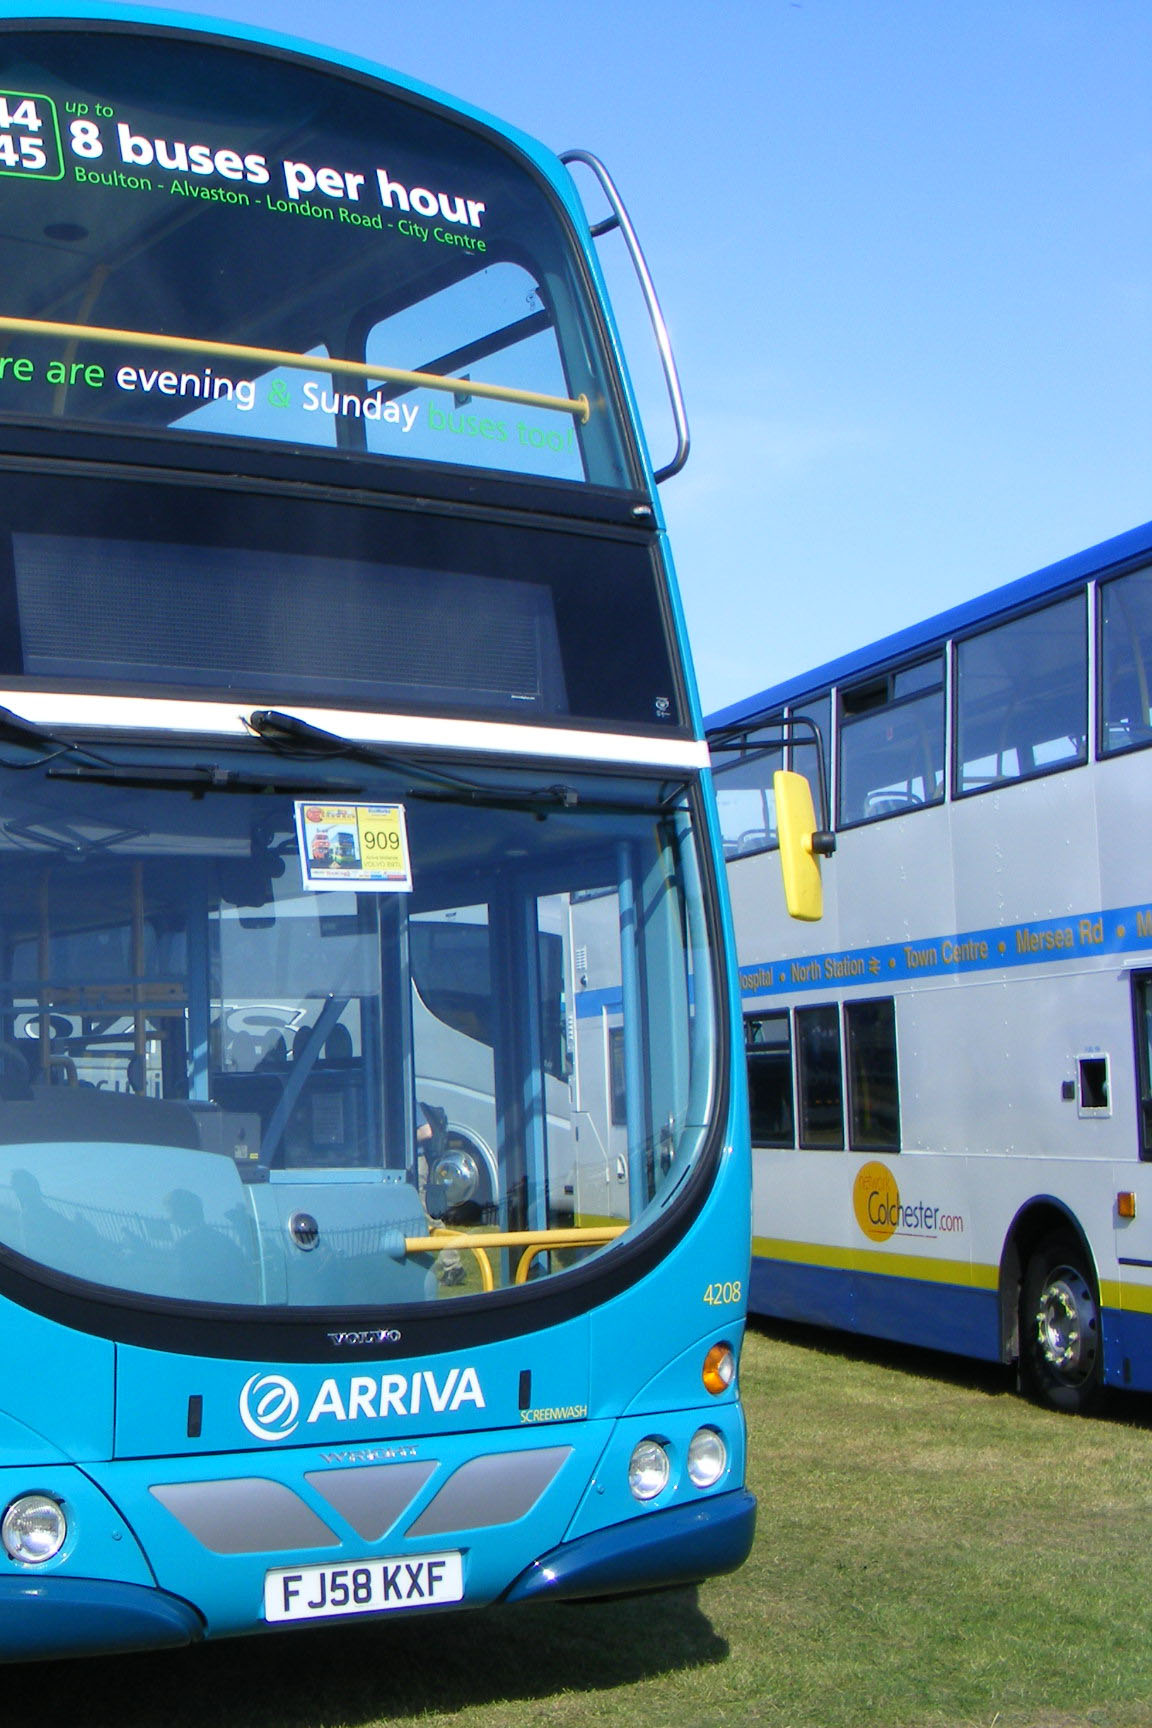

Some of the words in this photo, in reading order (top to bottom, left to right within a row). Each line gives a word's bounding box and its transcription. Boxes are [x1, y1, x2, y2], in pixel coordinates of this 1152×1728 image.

[65, 100, 88, 118] up
[95, 103, 114, 118] to
[69, 119, 103, 159] 8
[117, 122, 270, 184] buses
[283, 160, 365, 200] per
[376, 168, 486, 228] hour
[74, 166, 152, 191] Boulton
[170, 179, 250, 206] Alvaston
[266, 195, 334, 220] London
[339, 207, 383, 229] Road
[398, 220, 429, 242] City
[434, 227, 486, 252] Centre
[46, 360, 105, 388] are
[116, 365, 256, 411] evening
[267, 378, 291, 409] &
[302, 381, 419, 433] Sunday
[428, 401, 508, 442] buses
[364, 831, 400, 850] 909
[791, 960, 822, 983] North
[824, 956, 865, 979] Station
[904, 946, 938, 969] Town
[941, 940, 989, 964] Centre
[1015, 926, 1074, 953] Mersea
[1079, 917, 1104, 945] Rd
[703, 1281, 741, 1305] 4208
[328, 1329, 402, 1346] VOLVO
[307, 1367, 486, 1423] ARRIVA
[520, 1404, 588, 1423] SCREENWASH
[282, 1568, 373, 1612] FJ58
[382, 1560, 447, 1602] KXF
